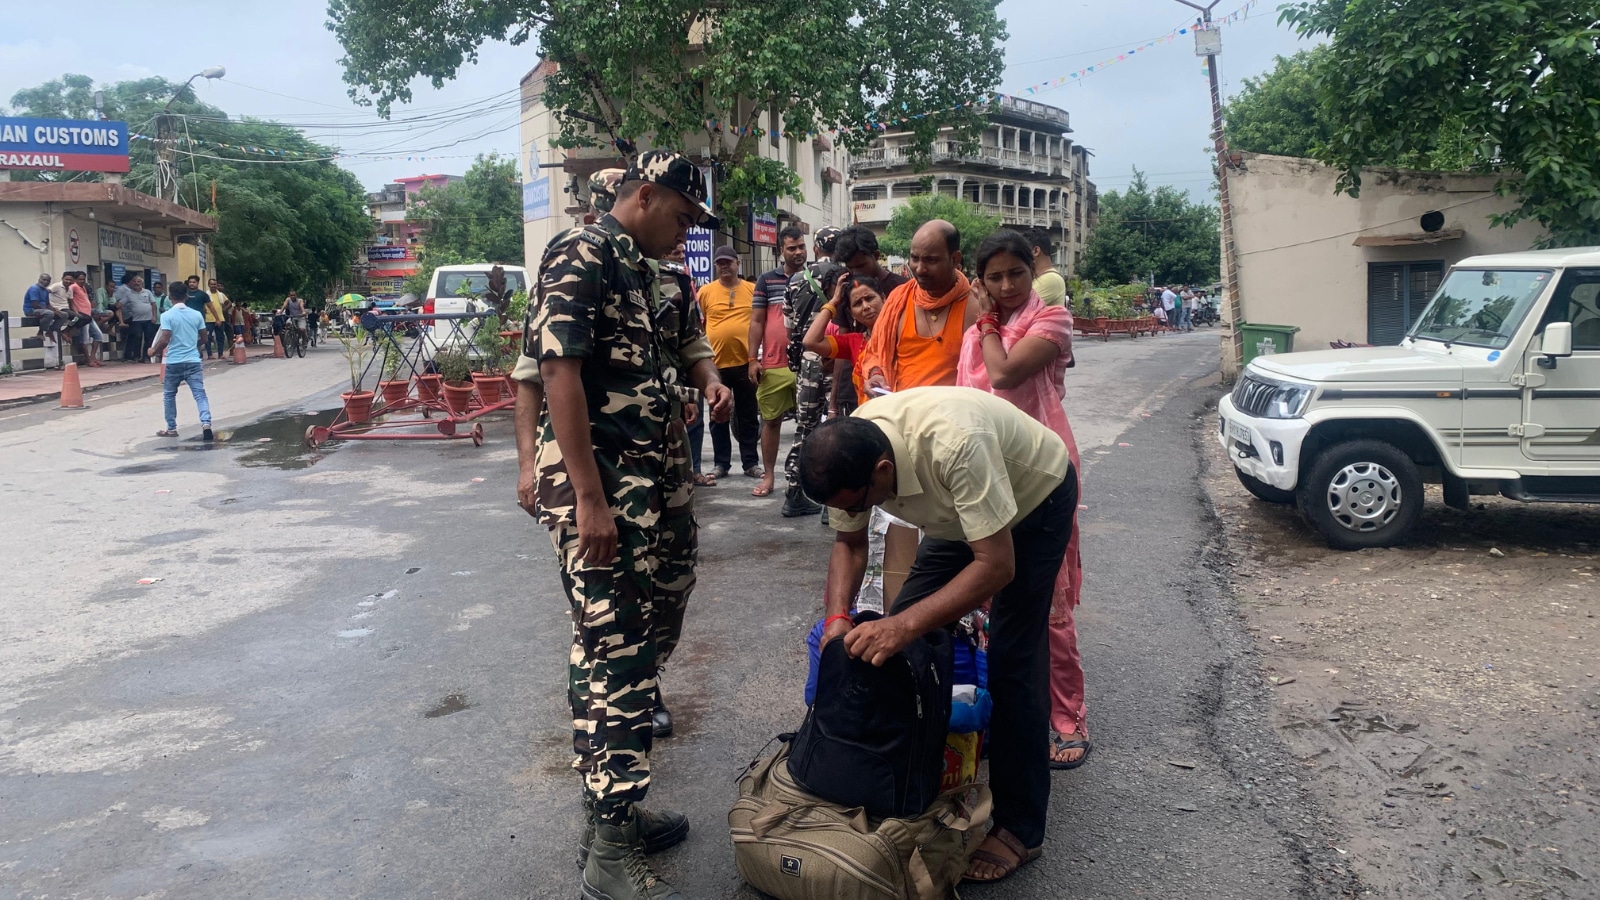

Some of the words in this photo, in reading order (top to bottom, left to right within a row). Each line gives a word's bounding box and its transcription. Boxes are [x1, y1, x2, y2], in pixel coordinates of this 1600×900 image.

[0, 124, 28, 143] AN
[34, 126, 119, 147] CUSTOMS
[0, 154, 65, 167] RAXAUL
[686, 224, 710, 235] IAN
[685, 239, 710, 253] TOMS
[687, 256, 710, 272] ND
